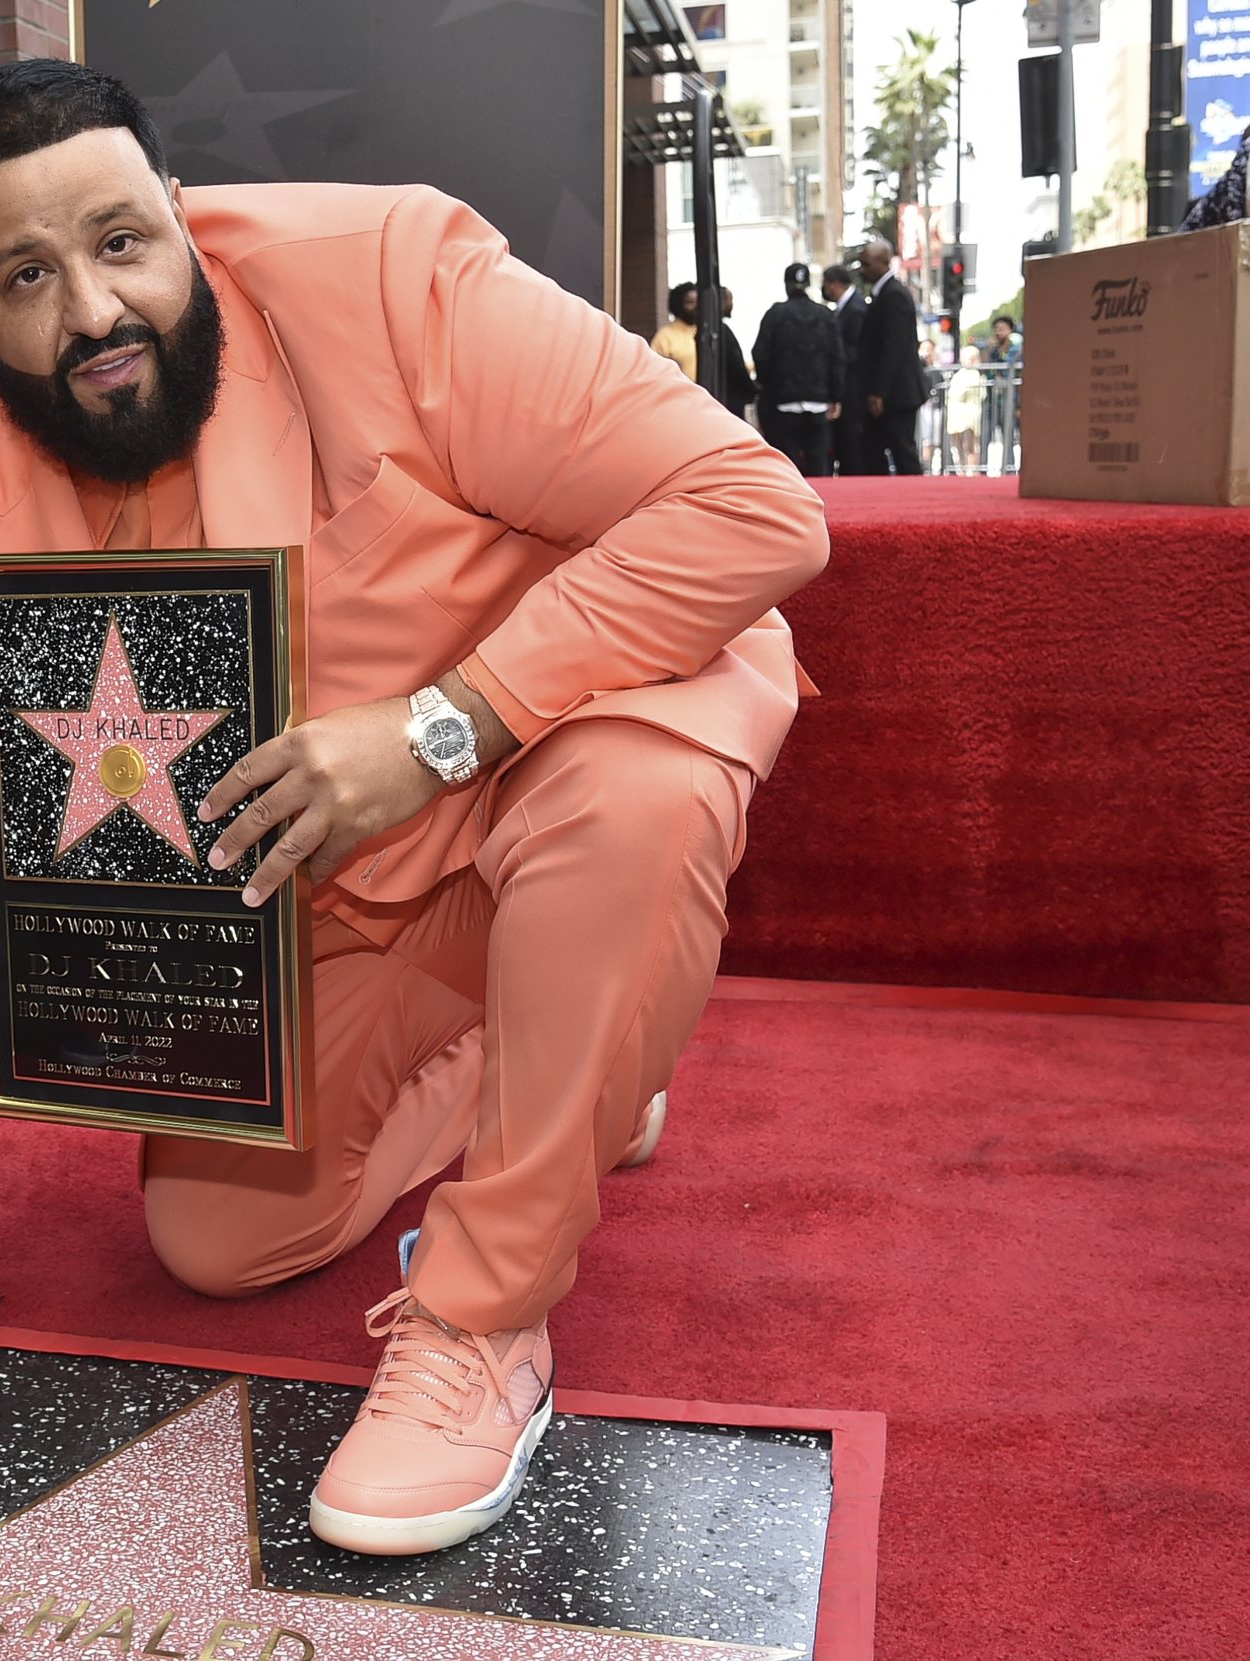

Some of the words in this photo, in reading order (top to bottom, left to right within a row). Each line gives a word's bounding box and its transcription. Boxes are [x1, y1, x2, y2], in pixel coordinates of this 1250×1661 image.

[1091, 276, 1148, 321] Funko
[57, 718, 82, 739] DJ
[96, 719, 190, 741] KHALED
[13, 914, 116, 937] HOLLYWOOD
[120, 920, 172, 940] WALK
[177, 924, 199, 941] OF
[205, 924, 255, 945] FAME
[28, 953, 71, 978] DJ
[88, 957, 244, 990] KHALED
[30, 984, 45, 995] THE
[47, 985, 82, 997] OCCASION
[85, 988, 95, 998] OF
[98, 989, 113, 1000] THE
[116, 990, 161, 1004] PLACEMENT
[164, 994, 175, 1004] OF
[178, 994, 201, 1006] YOUR
[204, 996, 225, 1008] STAR
[18, 1001, 119, 1025] HOLLYWOOD
[124, 1008, 175, 1030] WALK
[181, 1013, 202, 1031] OF
[209, 1015, 259, 1035] FAME
[145, 1036, 173, 1048] 2022
